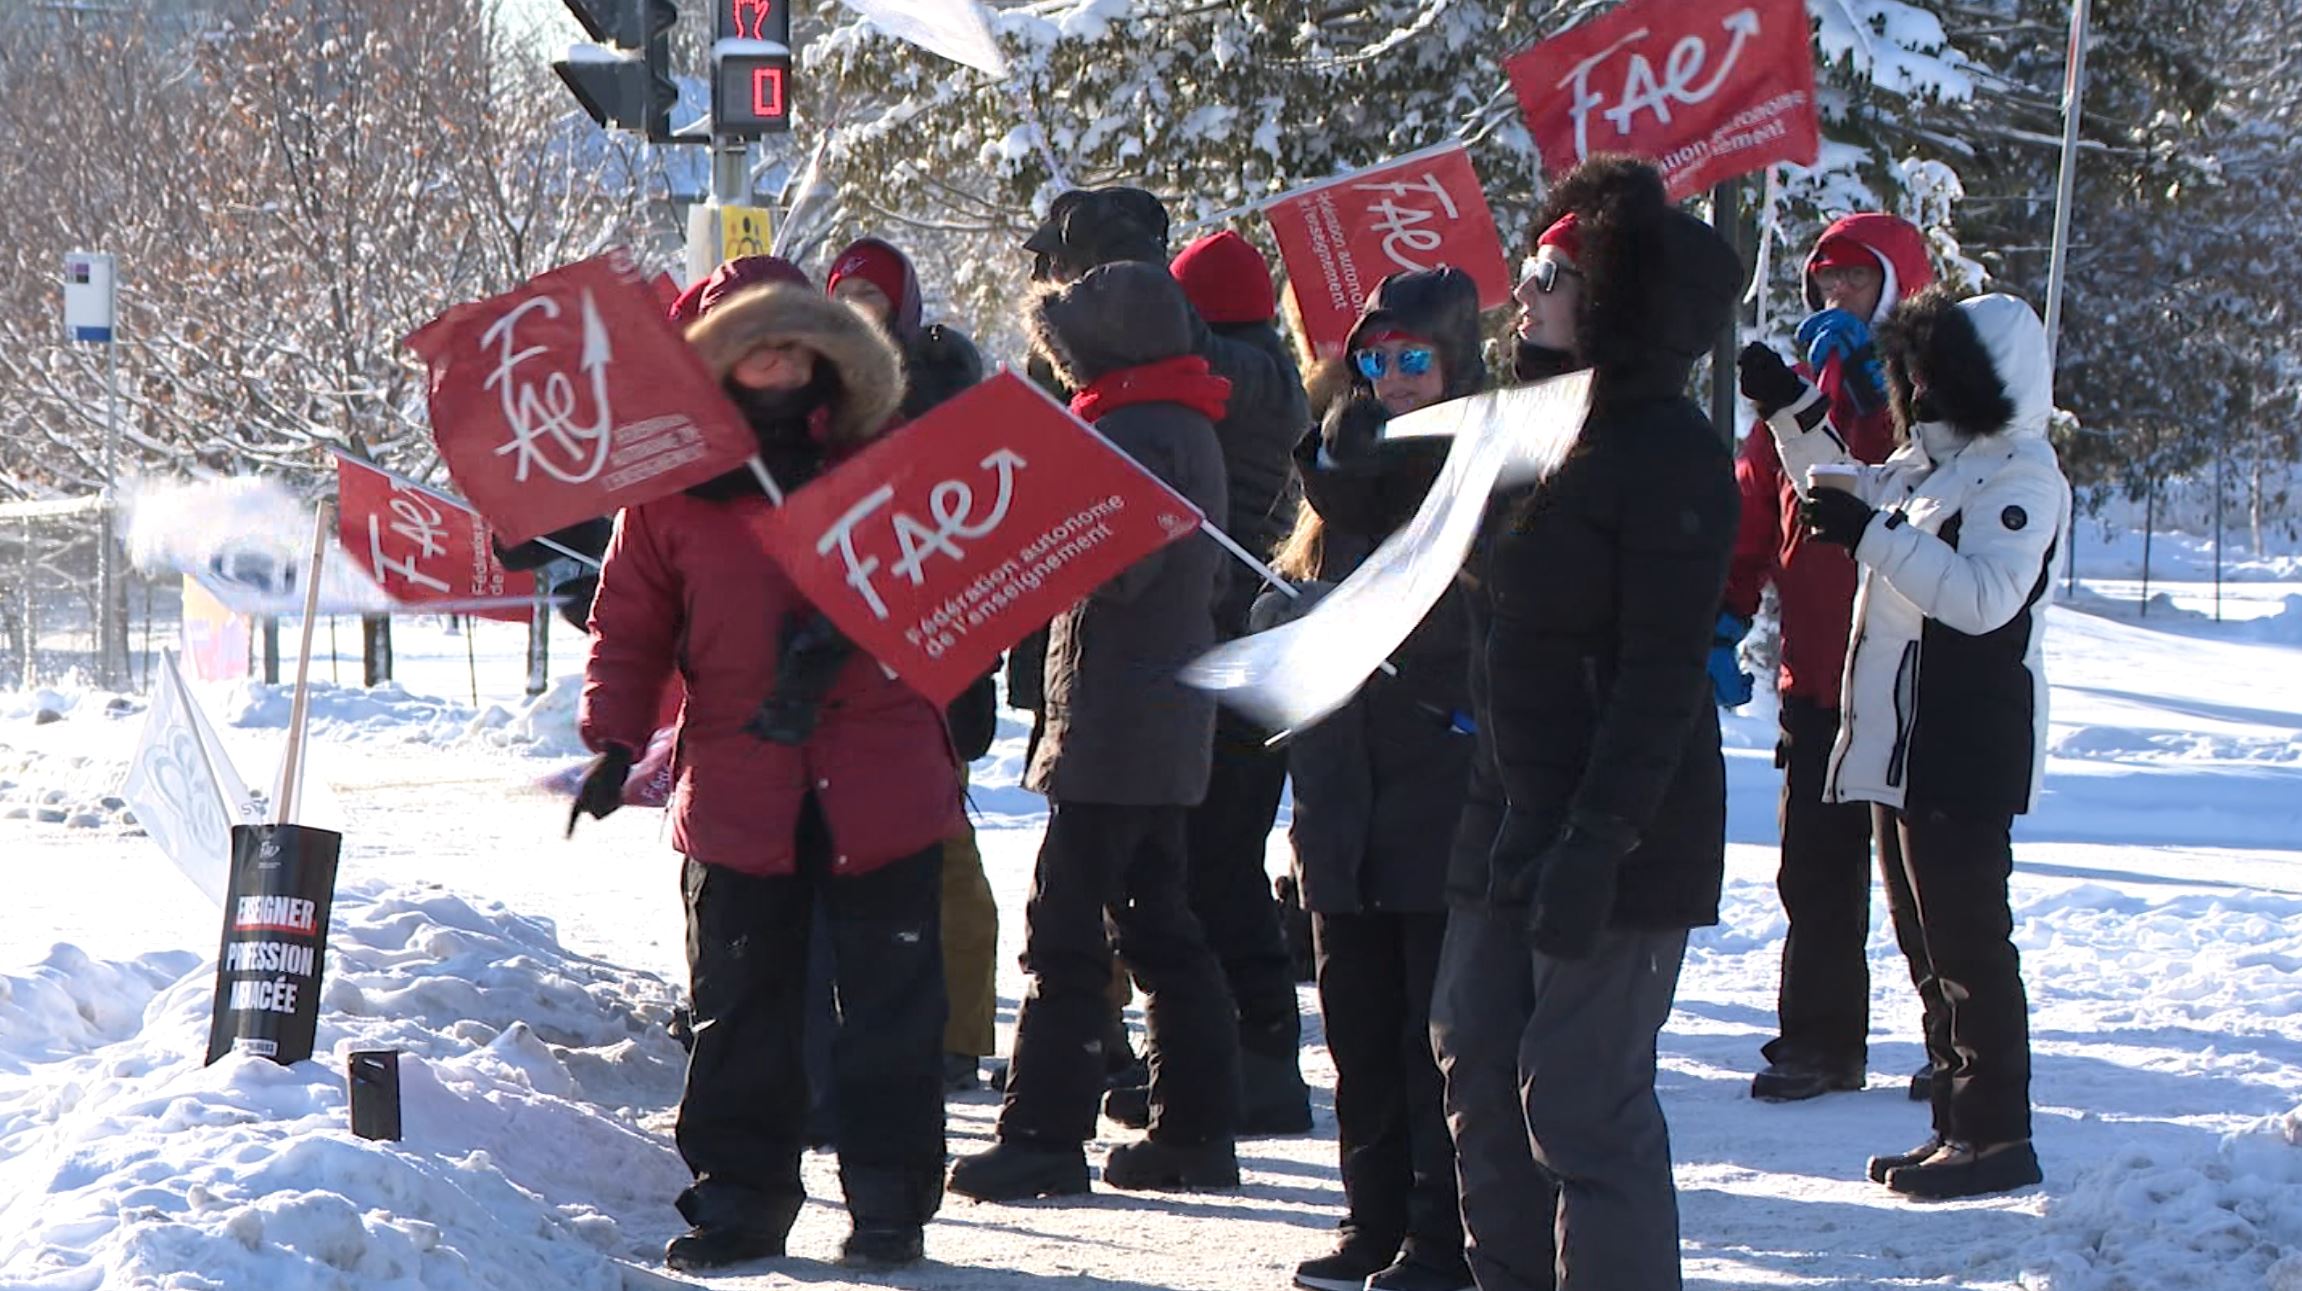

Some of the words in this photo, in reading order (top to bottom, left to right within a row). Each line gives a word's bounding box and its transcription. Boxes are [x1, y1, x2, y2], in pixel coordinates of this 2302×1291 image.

[753, 67, 782, 117] 0
[1337, 250, 1365, 320] autonom
[1019, 494, 1125, 564] autonome
[925, 630, 956, 659] de
